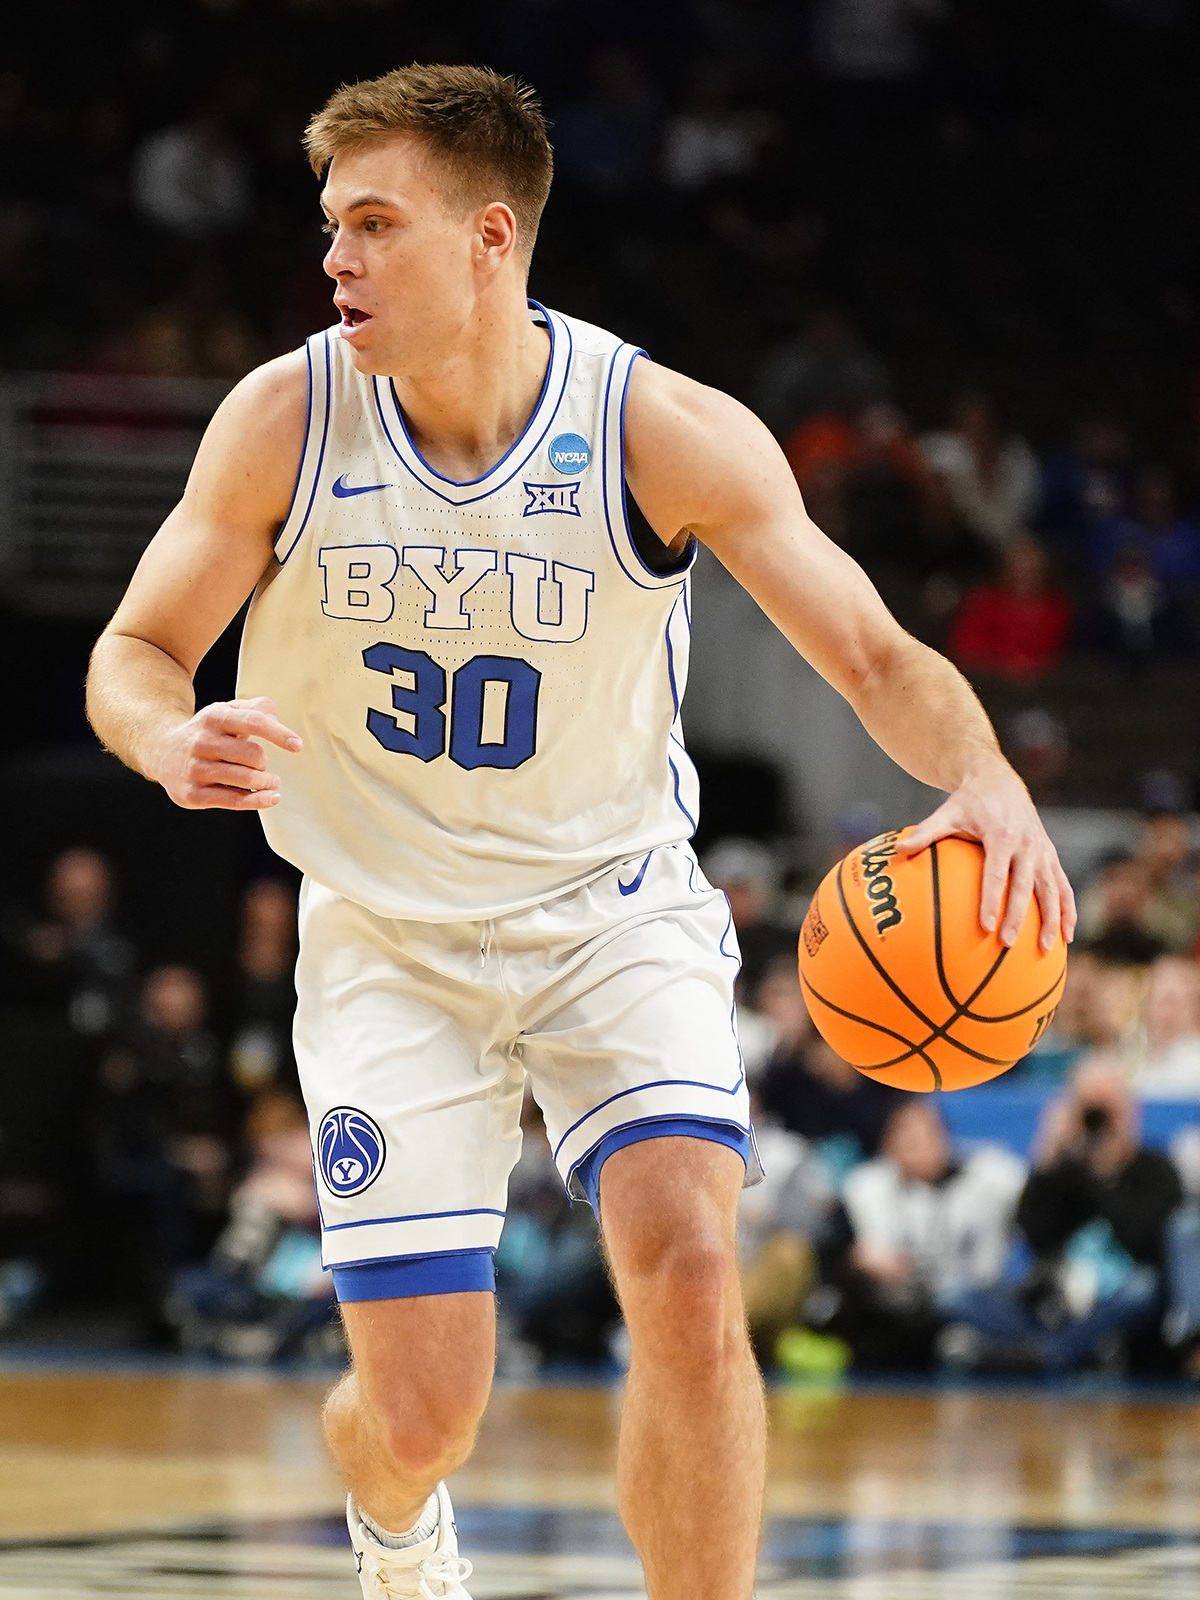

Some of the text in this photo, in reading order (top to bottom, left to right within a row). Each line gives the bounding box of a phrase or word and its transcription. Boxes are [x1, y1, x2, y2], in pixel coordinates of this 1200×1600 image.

[554, 451, 588, 464] NCAA
[522, 481, 582, 518] XII
[319, 545, 595, 643] BYU
[361, 641, 542, 771] 30
[861, 828, 903, 935] ilson
[336, 1161, 356, 1181] Y
